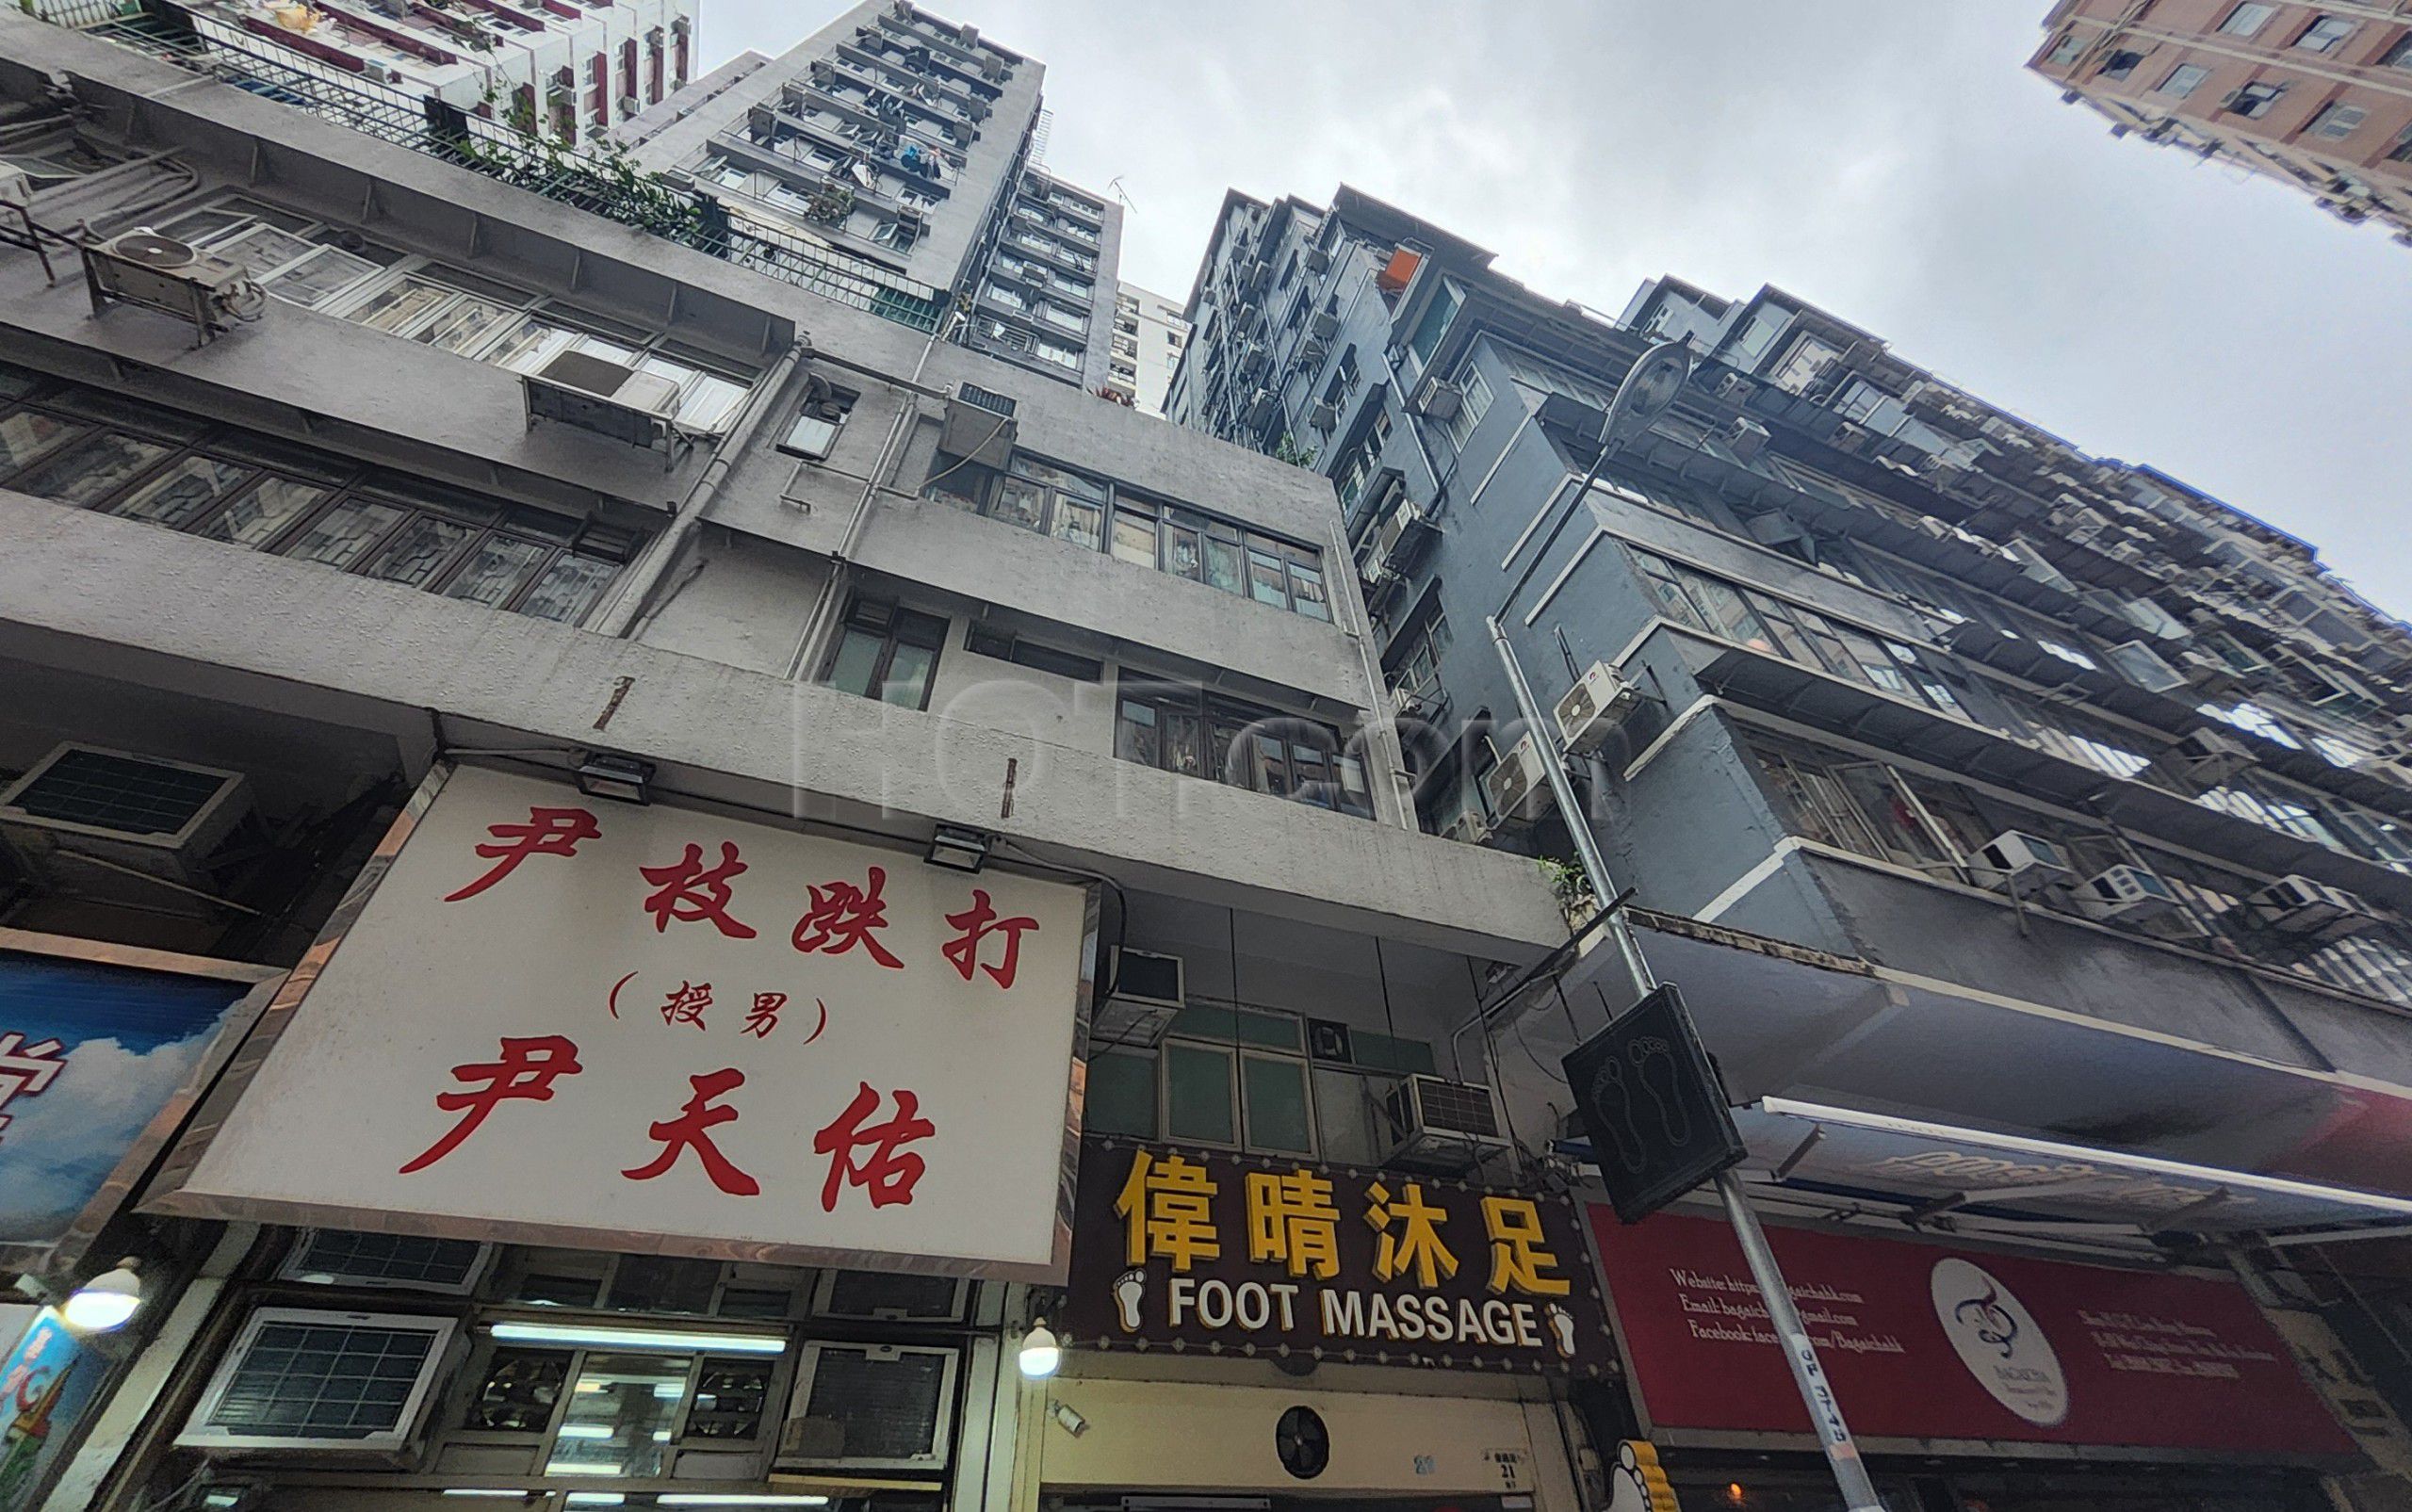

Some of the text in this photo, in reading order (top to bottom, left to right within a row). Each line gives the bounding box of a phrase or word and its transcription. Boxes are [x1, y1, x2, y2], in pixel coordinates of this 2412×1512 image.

[399, 1034, 936, 1212] 尹天佑
[1114, 1149, 1571, 1296] 偉晴沐足
[1168, 1276, 1544, 1348] FOOT MASSAGE
